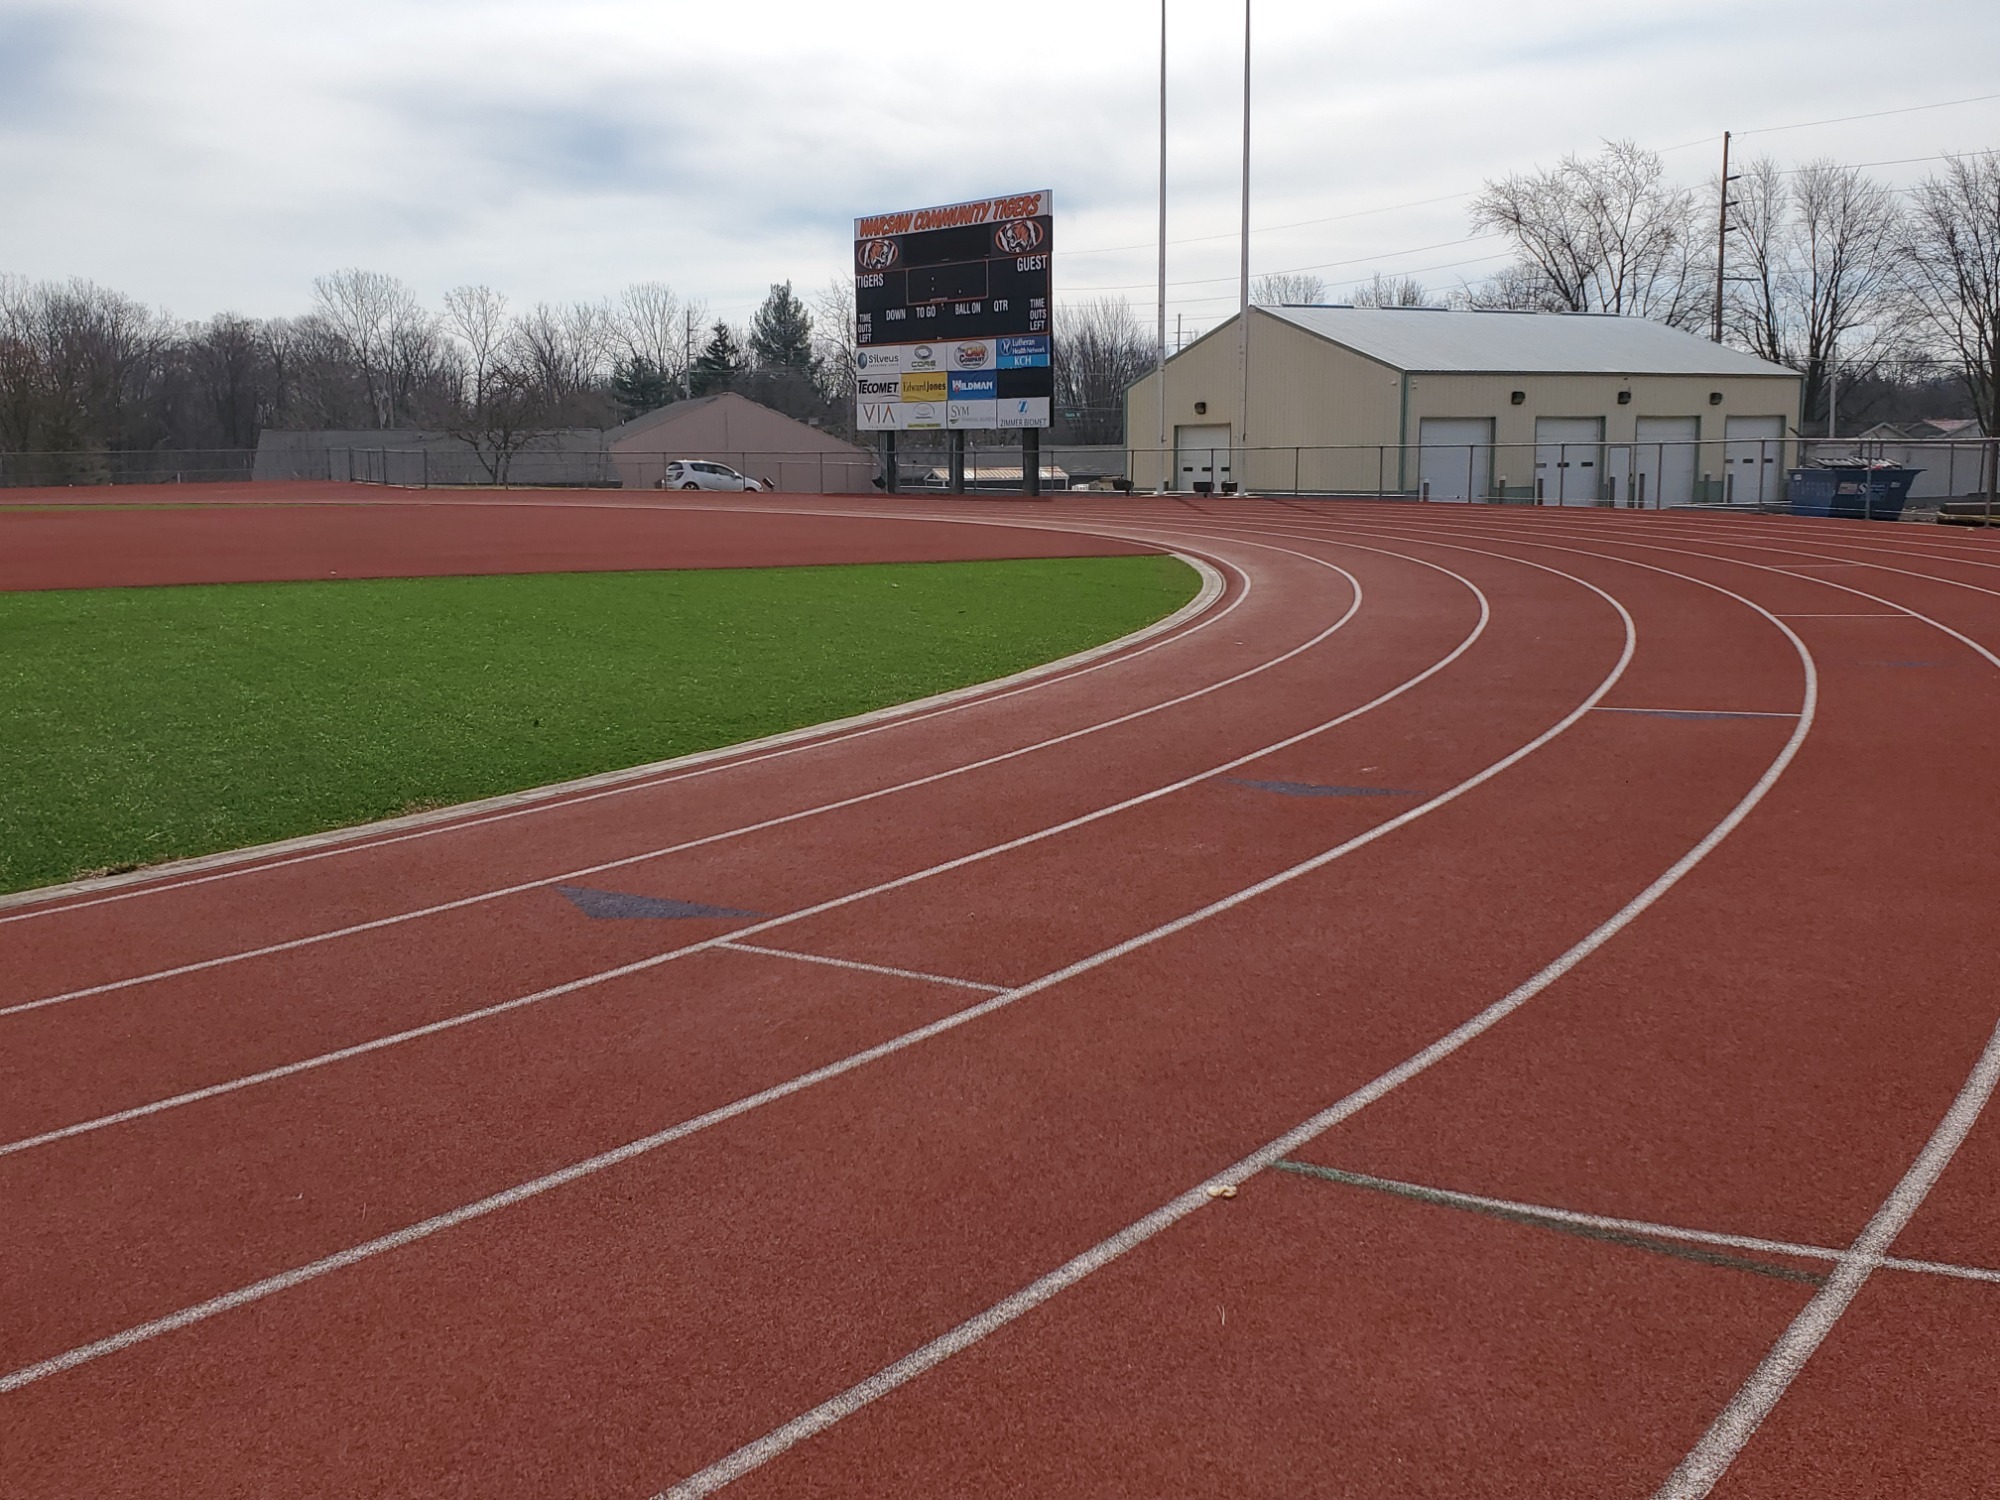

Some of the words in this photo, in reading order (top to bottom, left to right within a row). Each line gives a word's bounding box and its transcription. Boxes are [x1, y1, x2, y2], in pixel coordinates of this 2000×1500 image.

[860, 212, 913, 237] WARSAW
[914, 202, 991, 231] COMMUNITY
[993, 194, 1042, 219] TIGERS
[1017, 255, 1047, 272] GUEST
[856, 274, 884, 289] TIGERS
[954, 303, 971, 315] BALL
[971, 302, 981, 314] ON
[993, 300, 1009, 312] QTR
[1030, 298, 1045, 309] TIME
[885, 308, 906, 321] DOWN
[916, 307, 925, 318] TO
[925, 306, 936, 318] GO
[1029, 309, 1047, 320] OUTS
[858, 313, 872, 323] TIME
[857, 323, 872, 333] OUTS
[1029, 320, 1045, 331] LEFT
[858, 334, 872, 343] LEFT
[1012, 338, 1036, 347] Lutheran
[1012, 347, 1026, 355] Health
[1026, 345, 1045, 354] Network
[868, 353, 899, 364] Silveus
[1014, 355, 1032, 366] KCH
[863, 404, 896, 424] VIA
[1000, 418, 1023, 427] ZIMMER
[1023, 417, 1047, 427] BIOMET
